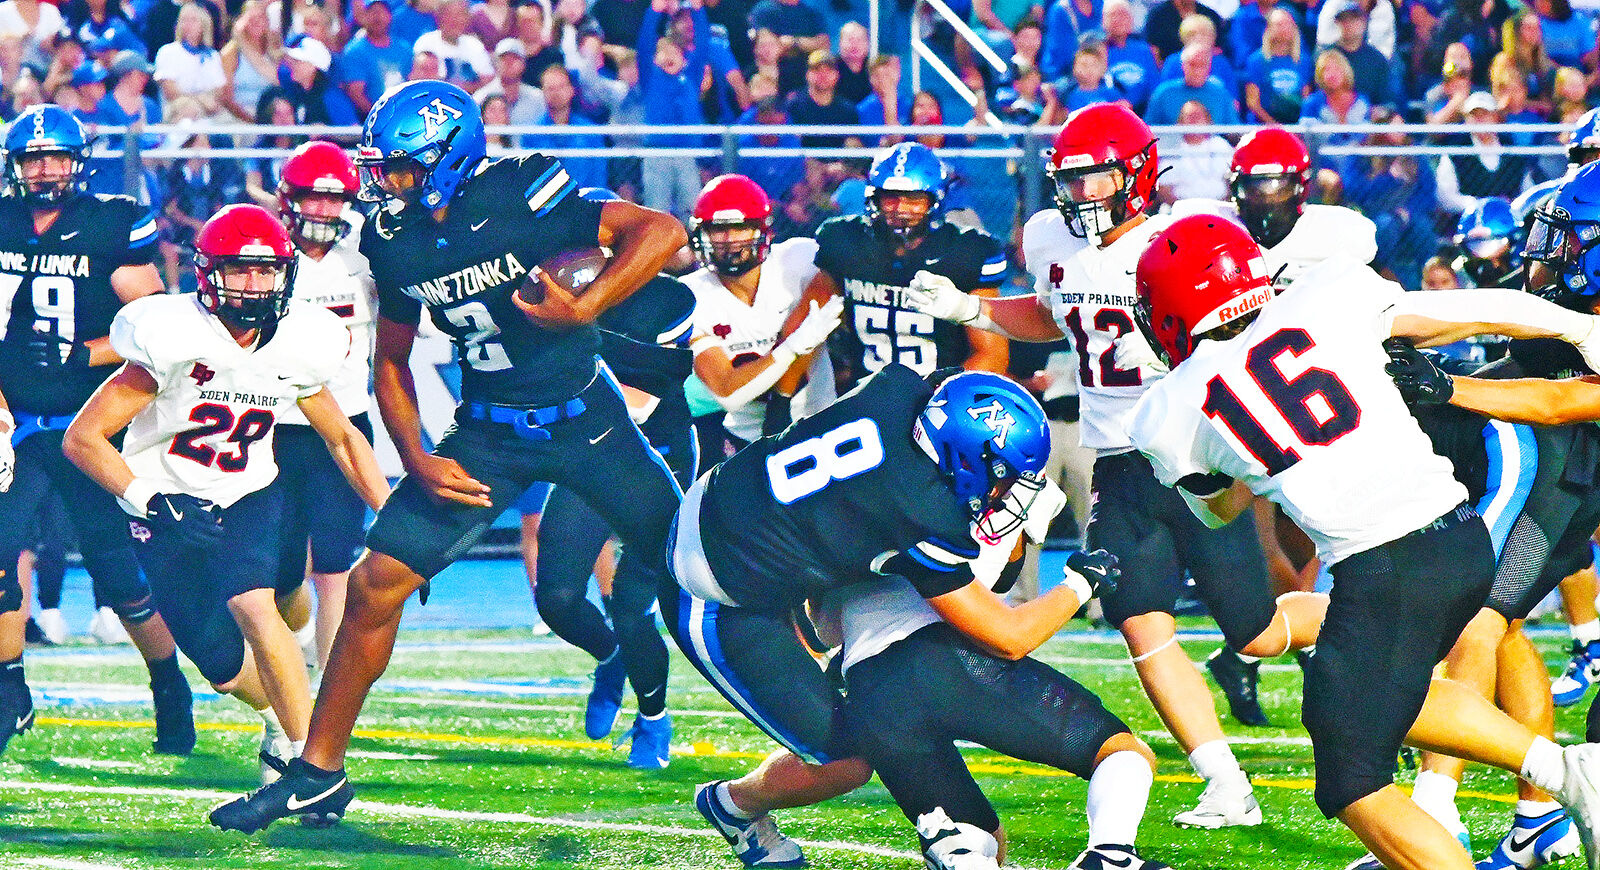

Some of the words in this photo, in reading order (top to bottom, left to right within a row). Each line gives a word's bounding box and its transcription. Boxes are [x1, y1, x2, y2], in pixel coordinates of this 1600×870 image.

[1061, 293, 1085, 304] EDEN
[1088, 294, 1135, 307] PRAIRIE
[1218, 289, 1272, 323] Riddell
[443, 301, 514, 372] 2
[854, 304, 938, 378] 55
[1064, 306, 1142, 387] 12
[199, 391, 230, 403] EDEN
[233, 392, 279, 407] PRAIRIE
[1201, 328, 1362, 478] 16
[168, 402, 275, 473] 29
[765, 416, 886, 506] 8
